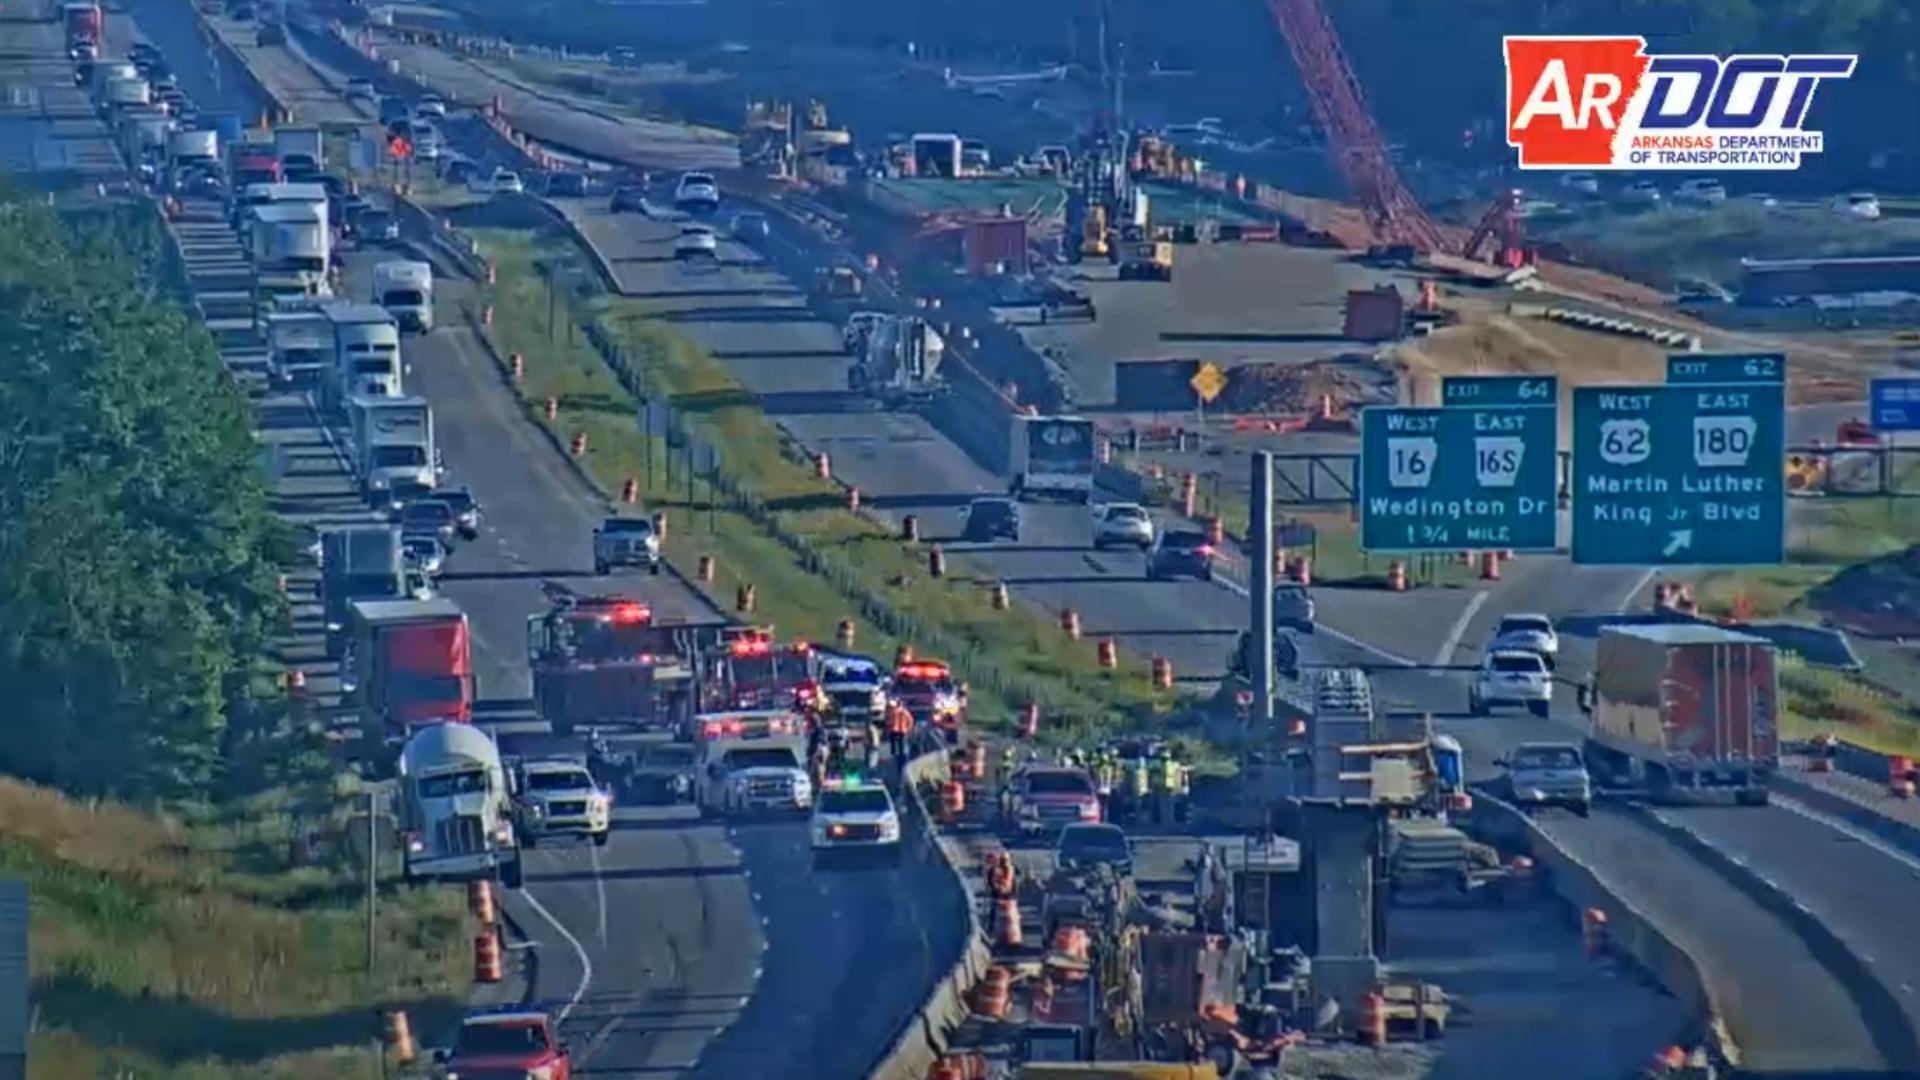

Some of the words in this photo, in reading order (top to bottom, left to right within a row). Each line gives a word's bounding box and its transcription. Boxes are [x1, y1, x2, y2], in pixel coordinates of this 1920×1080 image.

[1672, 362, 1708, 375] EXIT
[1743, 358, 1777, 376] 62
[1446, 383, 1481, 397] EXIT
[1517, 381, 1548, 399] 64
[1599, 393, 1652, 411] WEST
[1697, 393, 1750, 409] EAST
[1386, 413, 1439, 431] WEST
[1473, 412, 1527, 431] EAST
[1605, 427, 1646, 455] 62
[1697, 427, 1749, 455] 180
[1396, 448, 1426, 475] 16
[1479, 448, 1517, 474] 16S
[1587, 473, 1669, 493] Martin
[1682, 472, 1765, 493] Luther
[1369, 496, 1505, 520] Wedington
[1517, 496, 1548, 515] Dr
[1593, 503, 1652, 526] King
[1666, 506, 1688, 521] Jr
[1702, 501, 1761, 521] Blvd
[1466, 526, 1511, 542] MILE
